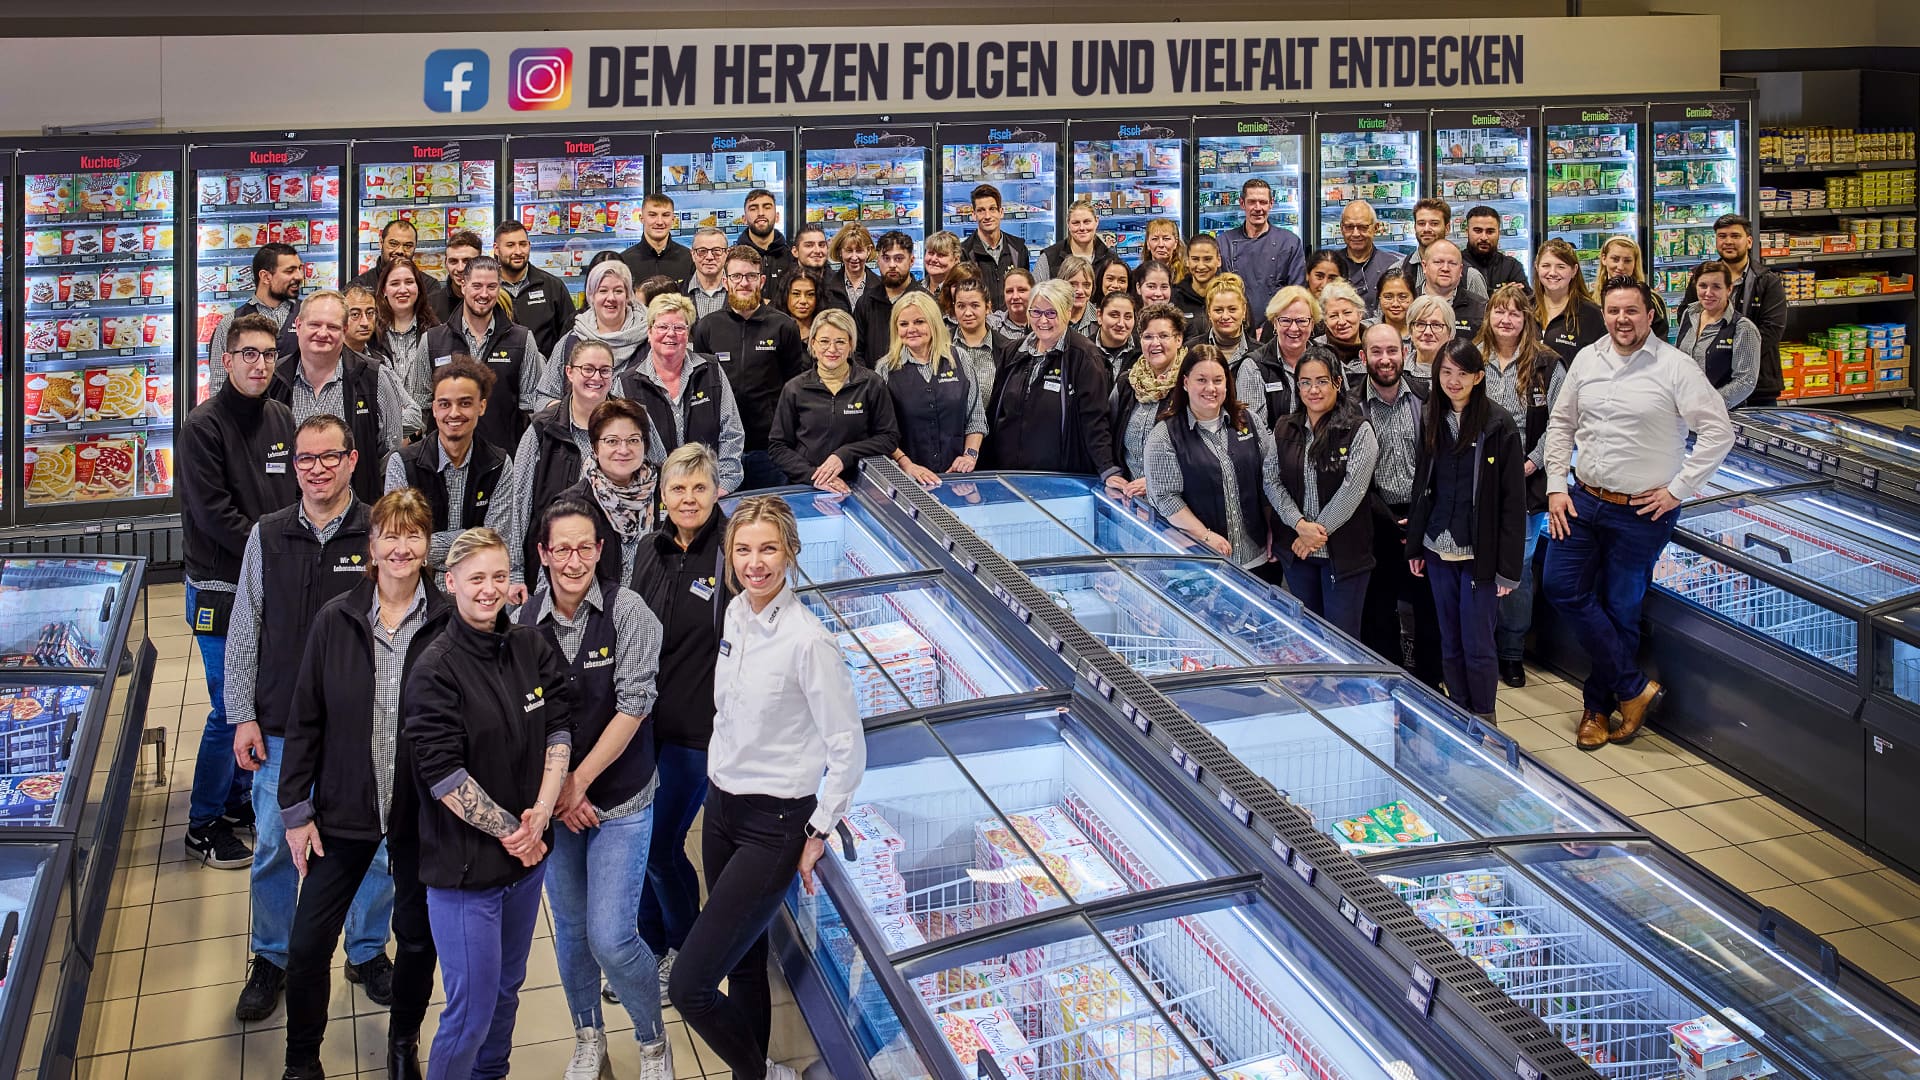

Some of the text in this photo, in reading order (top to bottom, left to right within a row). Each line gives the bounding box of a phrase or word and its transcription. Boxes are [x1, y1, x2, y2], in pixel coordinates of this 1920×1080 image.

[588, 35, 1523, 108] DEM HERZEN FOLGEN UND VIELFALT ENTDECKEN
[1582, 111, 1609, 121] Gemüse
[1686, 107, 1713, 118] Gemüse
[1358, 118, 1386, 129] Kräuter
[1472, 114, 1501, 125] Gemüse
[1120, 125, 1141, 136] Fisch
[1237, 121, 1268, 133] Gemüse
[855, 132, 879, 145] Fisch
[990, 128, 1012, 140] Fisch
[564, 141, 595, 153] Torten
[713, 137, 737, 149] Fisch
[250, 151, 288, 164] Kuchen
[413, 146, 444, 158] Torten
[80, 156, 120, 169] Kuchen
[588, 651, 599, 659] Wir
